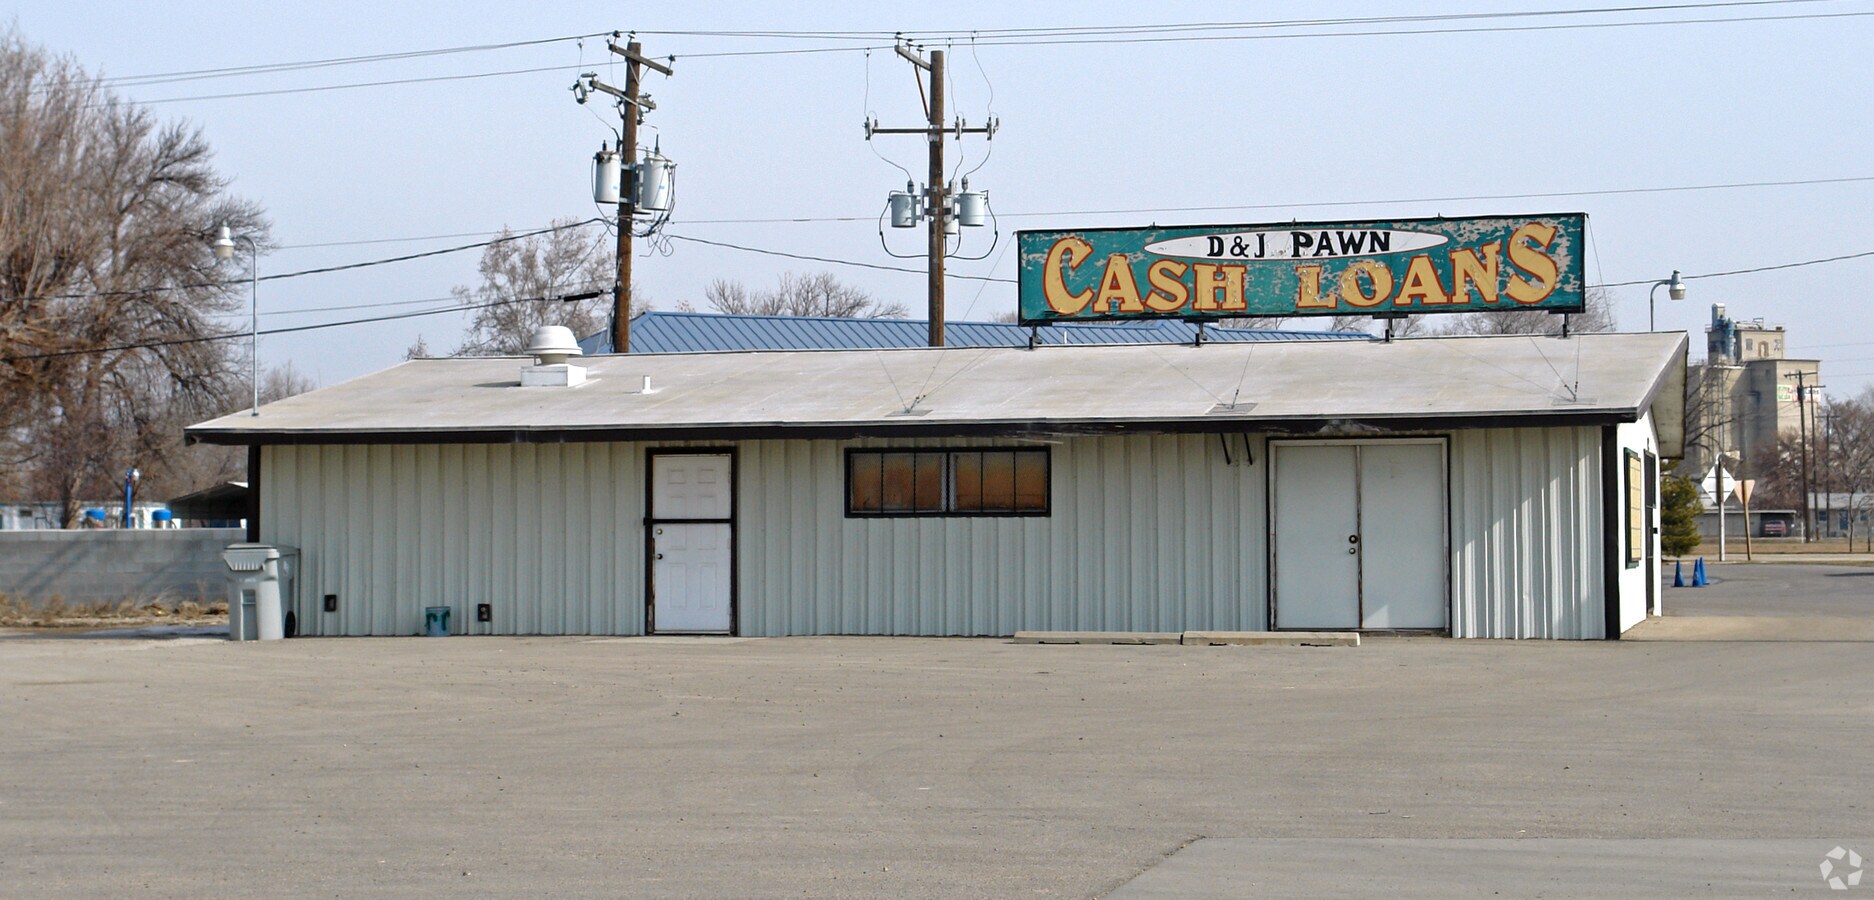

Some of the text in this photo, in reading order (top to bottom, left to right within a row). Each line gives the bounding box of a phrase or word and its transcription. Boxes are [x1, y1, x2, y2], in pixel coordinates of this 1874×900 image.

[1043, 221, 1559, 316] CASH LOANS
[1290, 231, 1391, 258] PAWN
